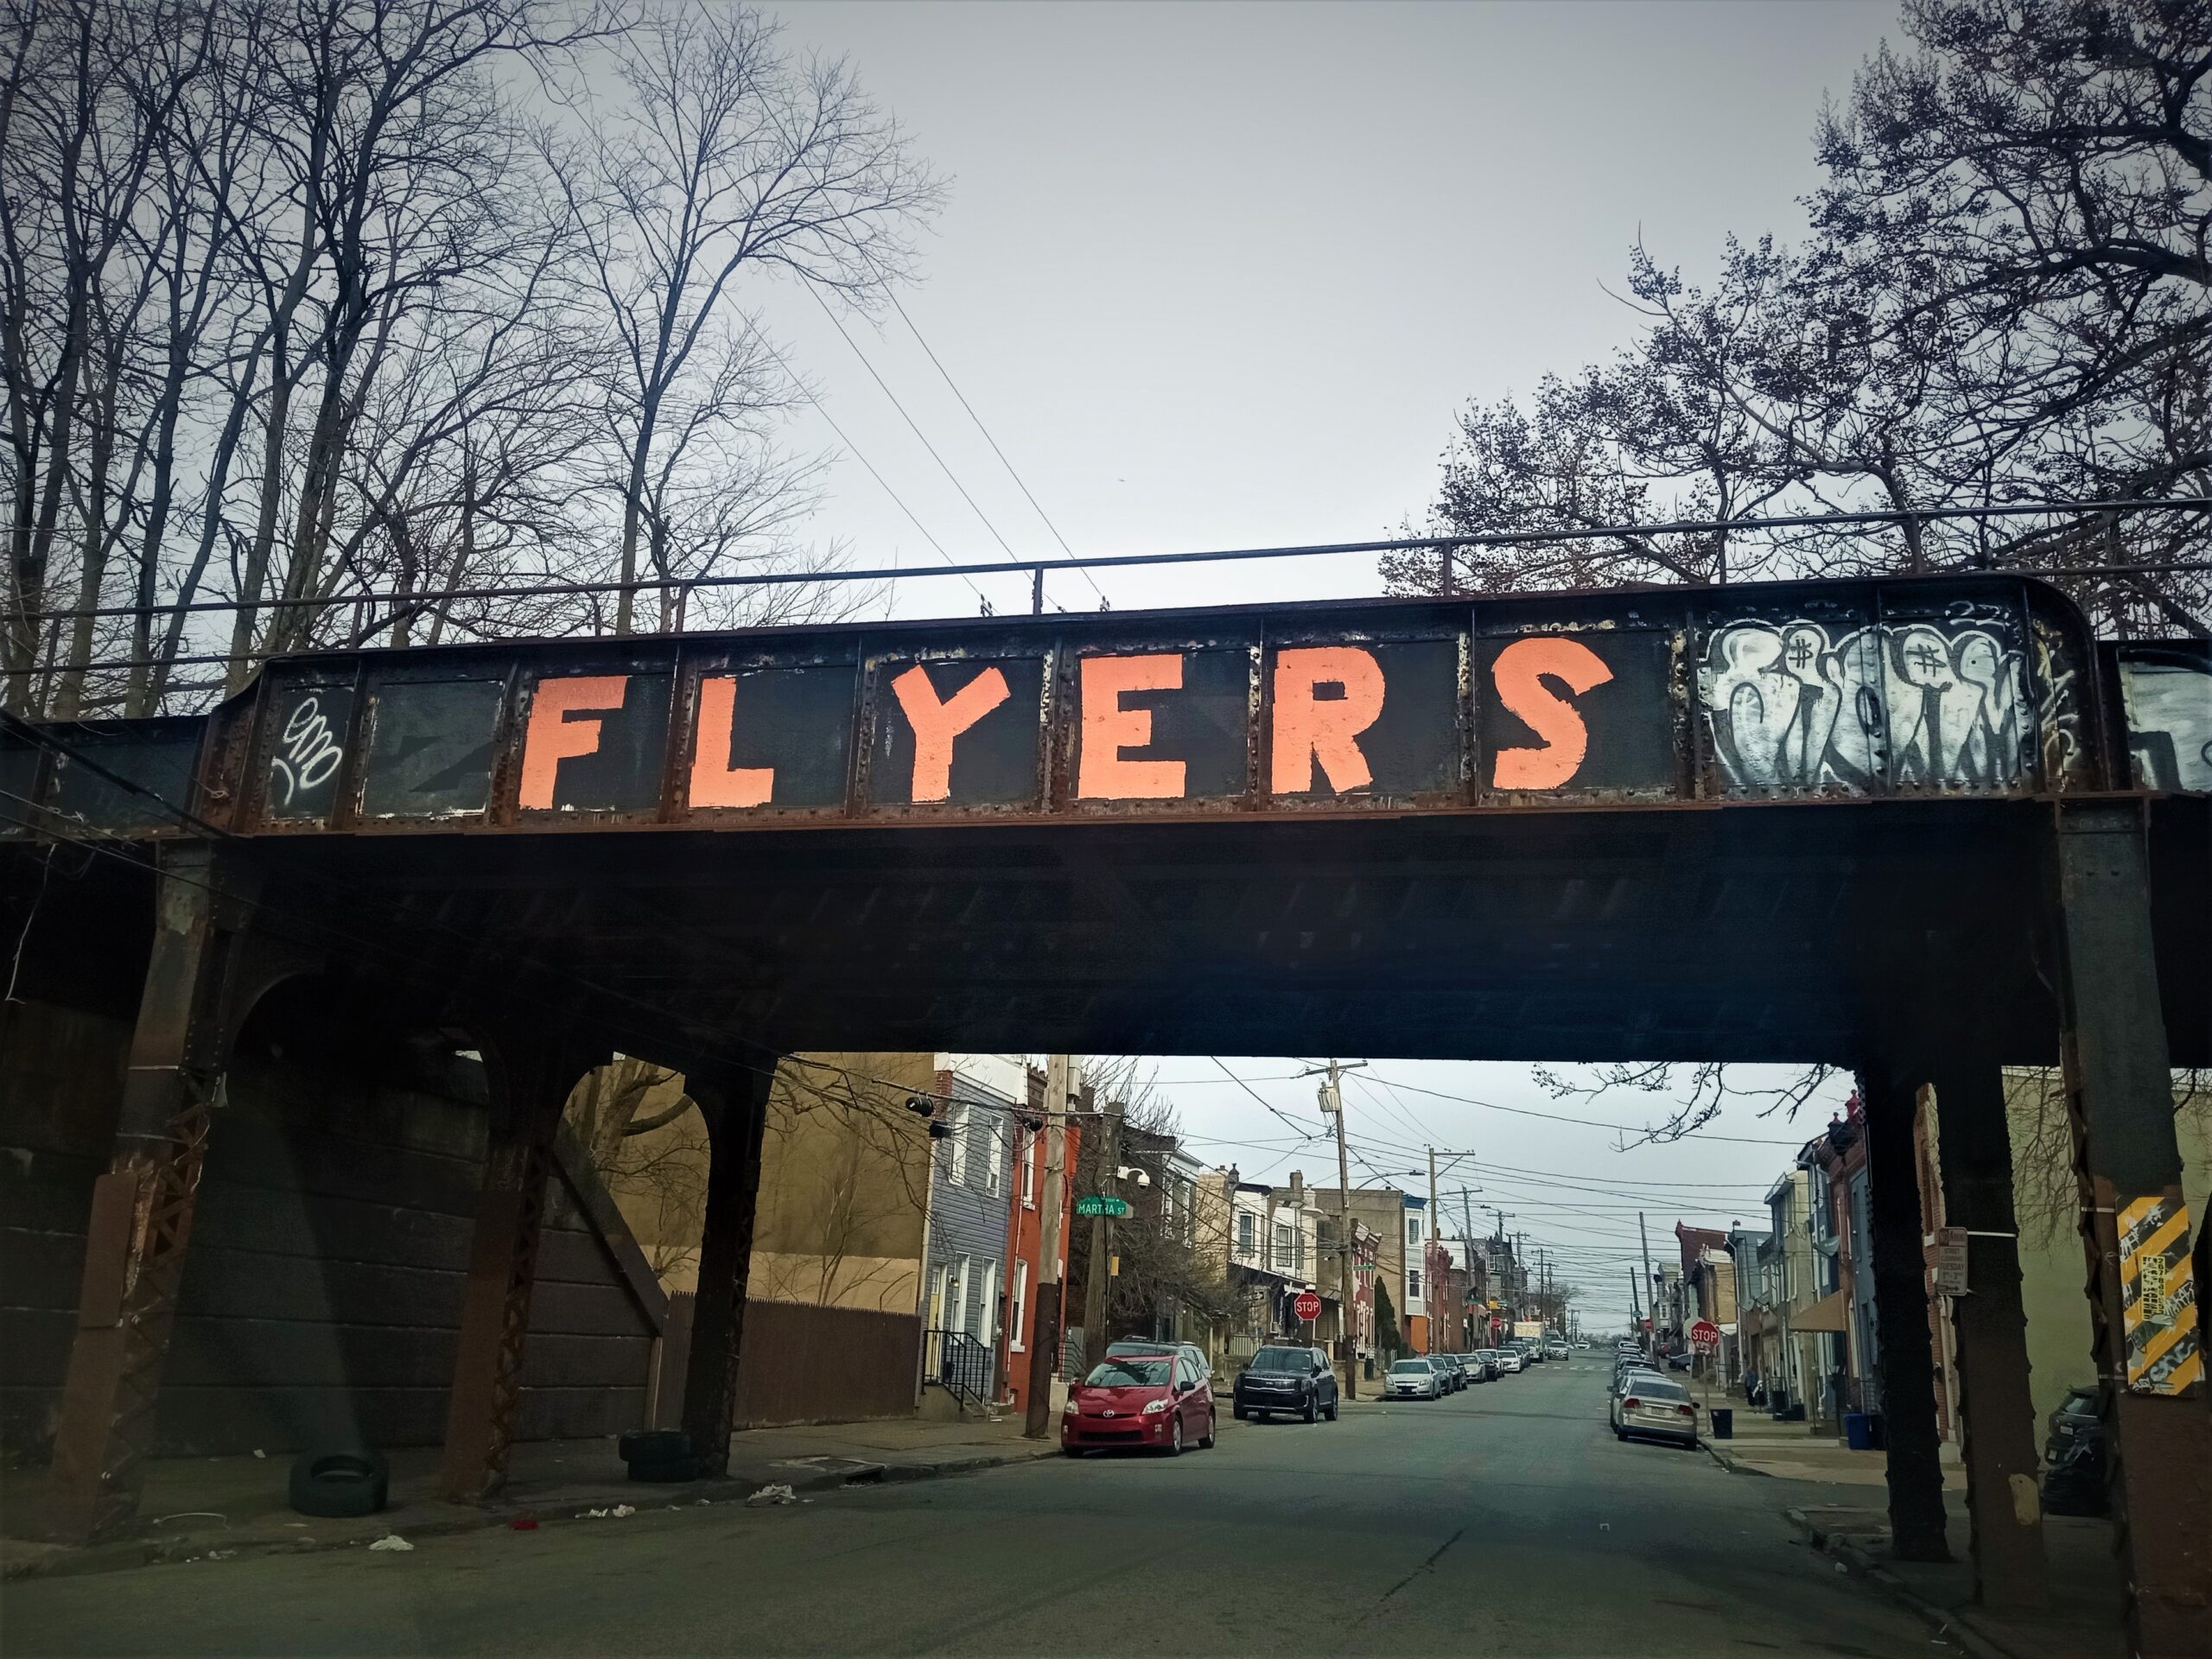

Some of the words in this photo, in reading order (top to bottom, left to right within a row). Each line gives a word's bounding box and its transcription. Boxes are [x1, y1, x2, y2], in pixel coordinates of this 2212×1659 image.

[518, 637, 1614, 811] FLYERS
[1078, 1204, 1115, 1215] MARTHA
[1296, 1301, 1319, 1313] STOP
[1692, 1329, 1718, 1342] STOP
